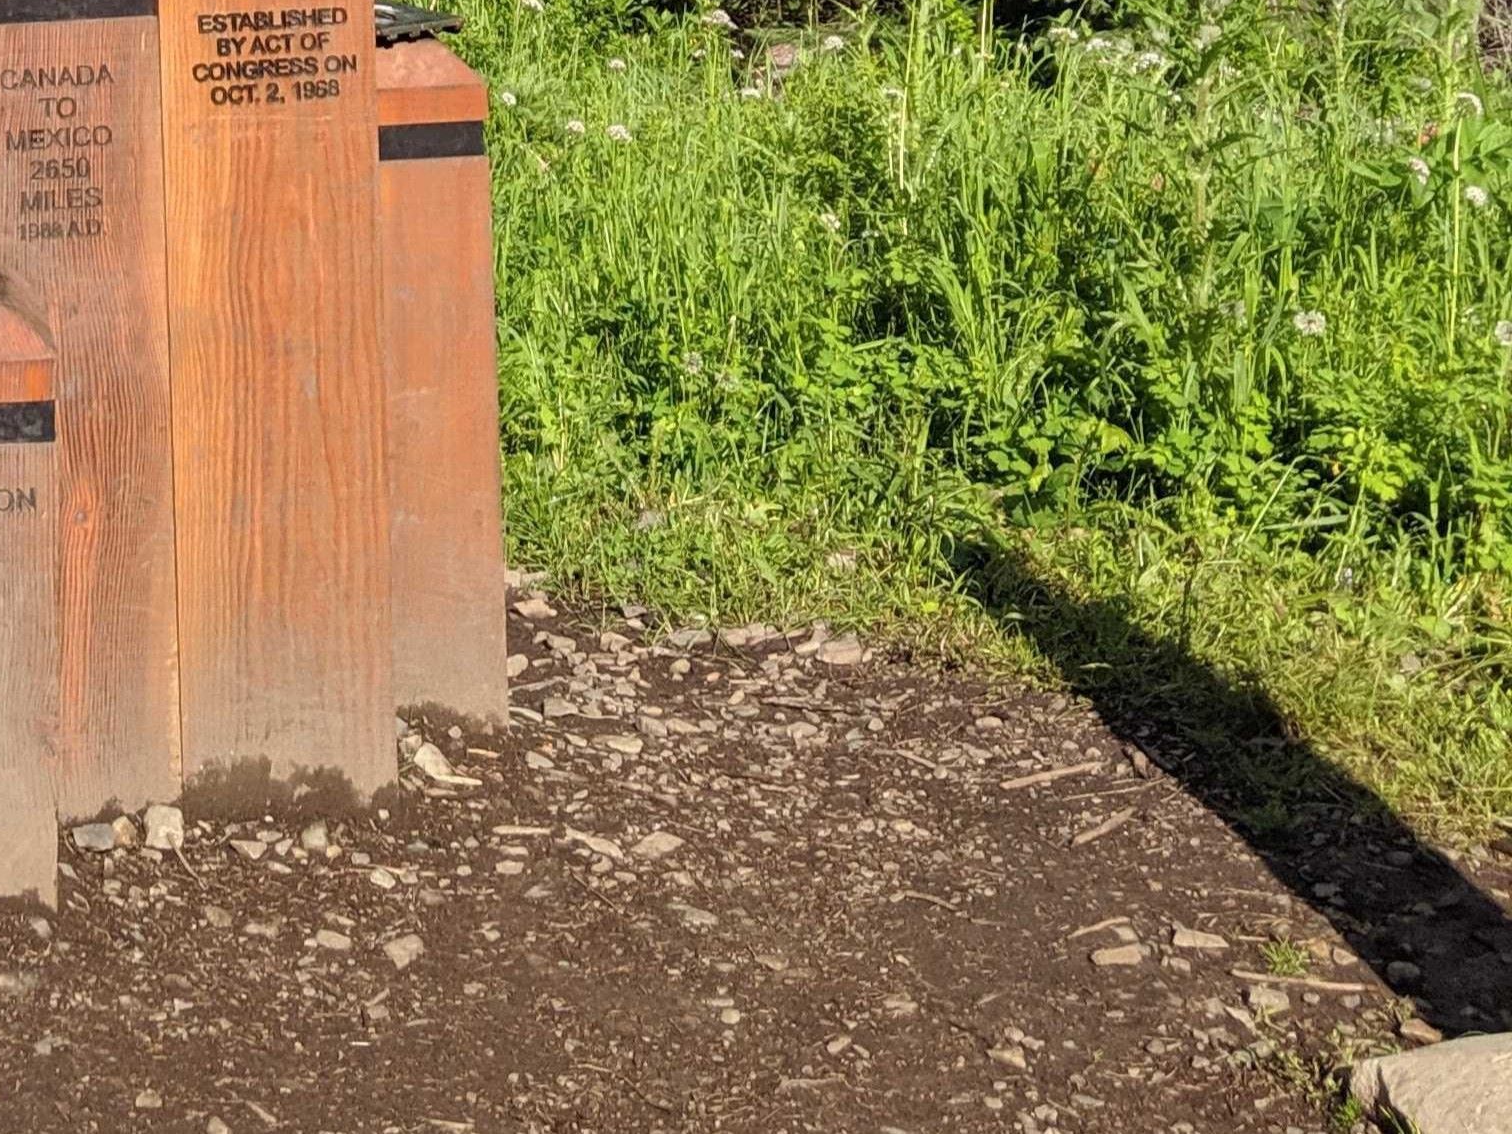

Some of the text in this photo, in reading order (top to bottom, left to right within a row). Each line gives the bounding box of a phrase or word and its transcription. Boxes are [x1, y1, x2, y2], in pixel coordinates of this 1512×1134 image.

[197, 7, 347, 34] ESTABLISHED
[216, 31, 330, 57] BY ACT OF
[0, 64, 115, 91] CANADA
[192, 54, 357, 83] CONGRESS ON
[210, 79, 340, 105] OCT. 2, 1968
[38, 96, 77, 118] TO
[6, 125, 113, 152] MEXICO
[29, 156, 91, 180] 2650
[20, 186, 103, 213] MILES
